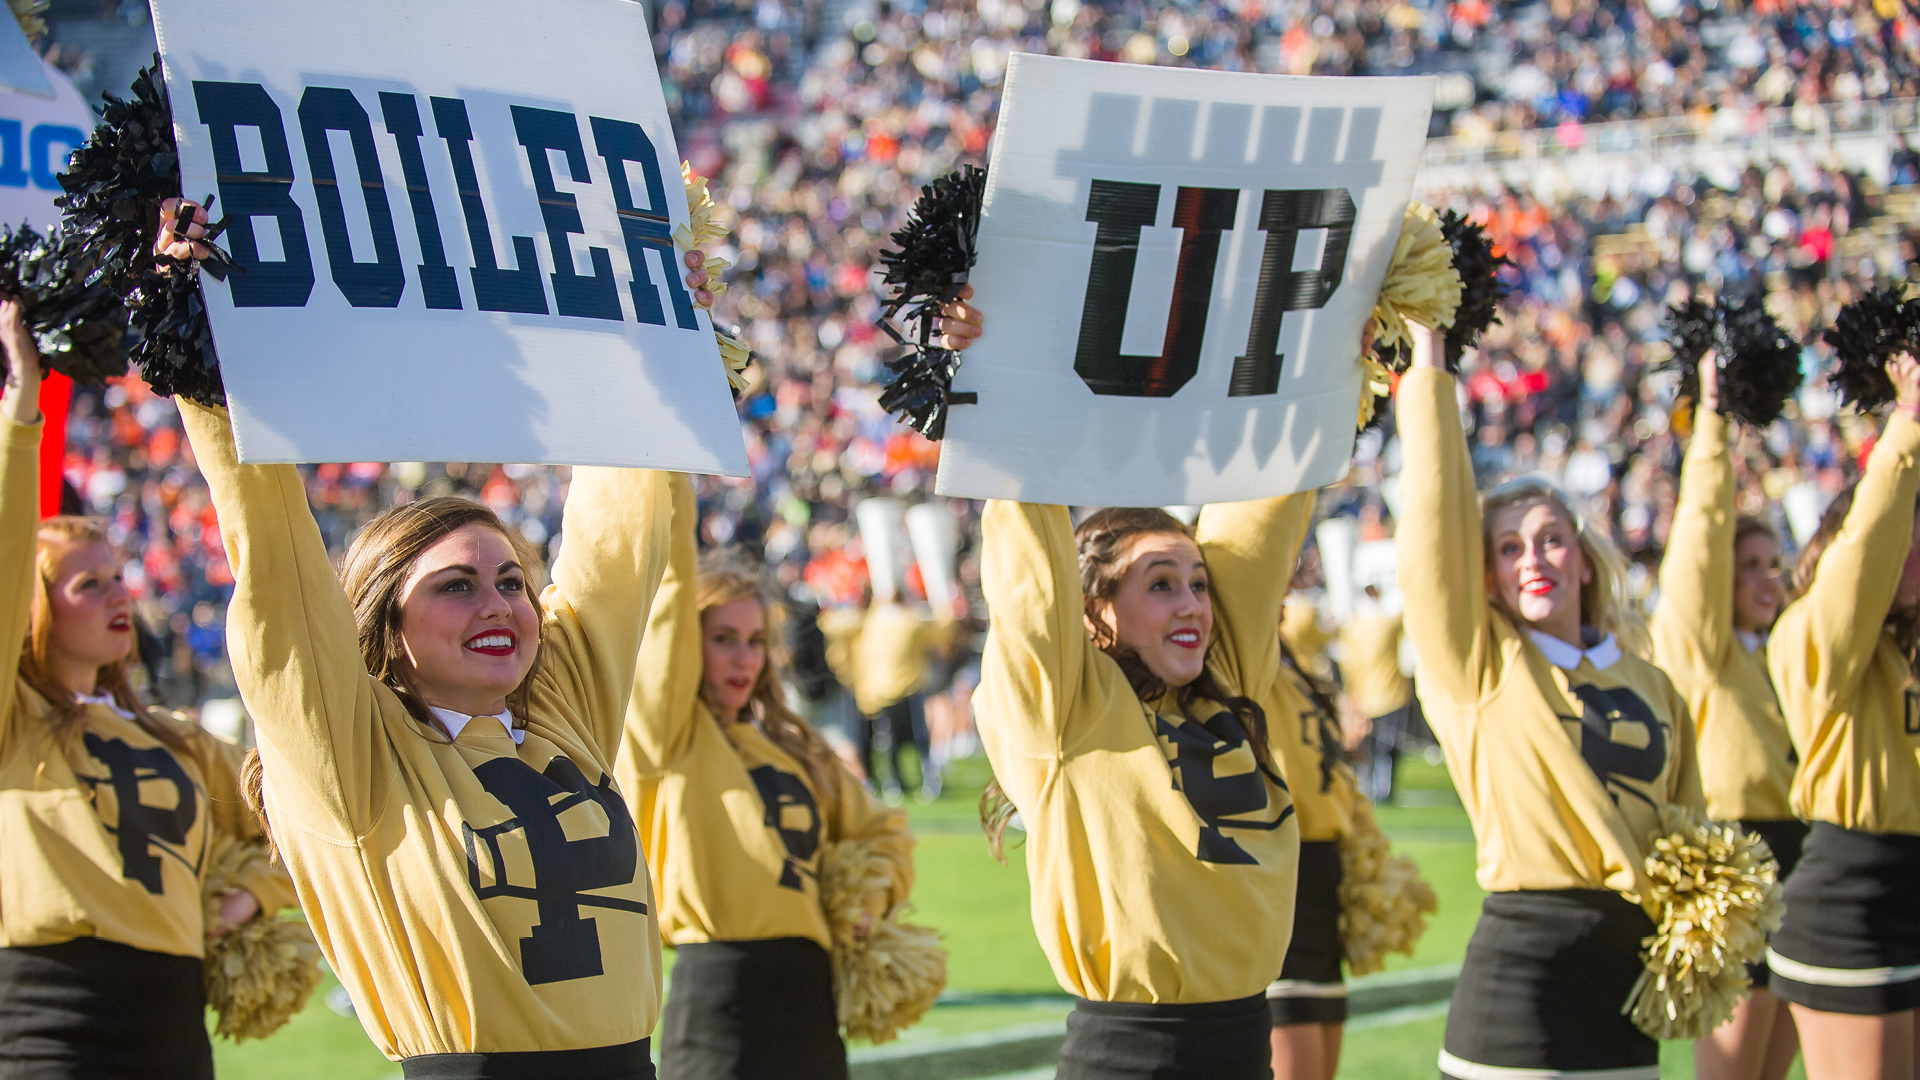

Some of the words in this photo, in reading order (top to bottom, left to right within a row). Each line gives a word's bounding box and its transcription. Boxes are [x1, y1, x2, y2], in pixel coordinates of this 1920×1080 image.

[192, 80, 700, 331] BOILER
[1073, 178, 1358, 398] UP
[472, 755, 638, 987] P
